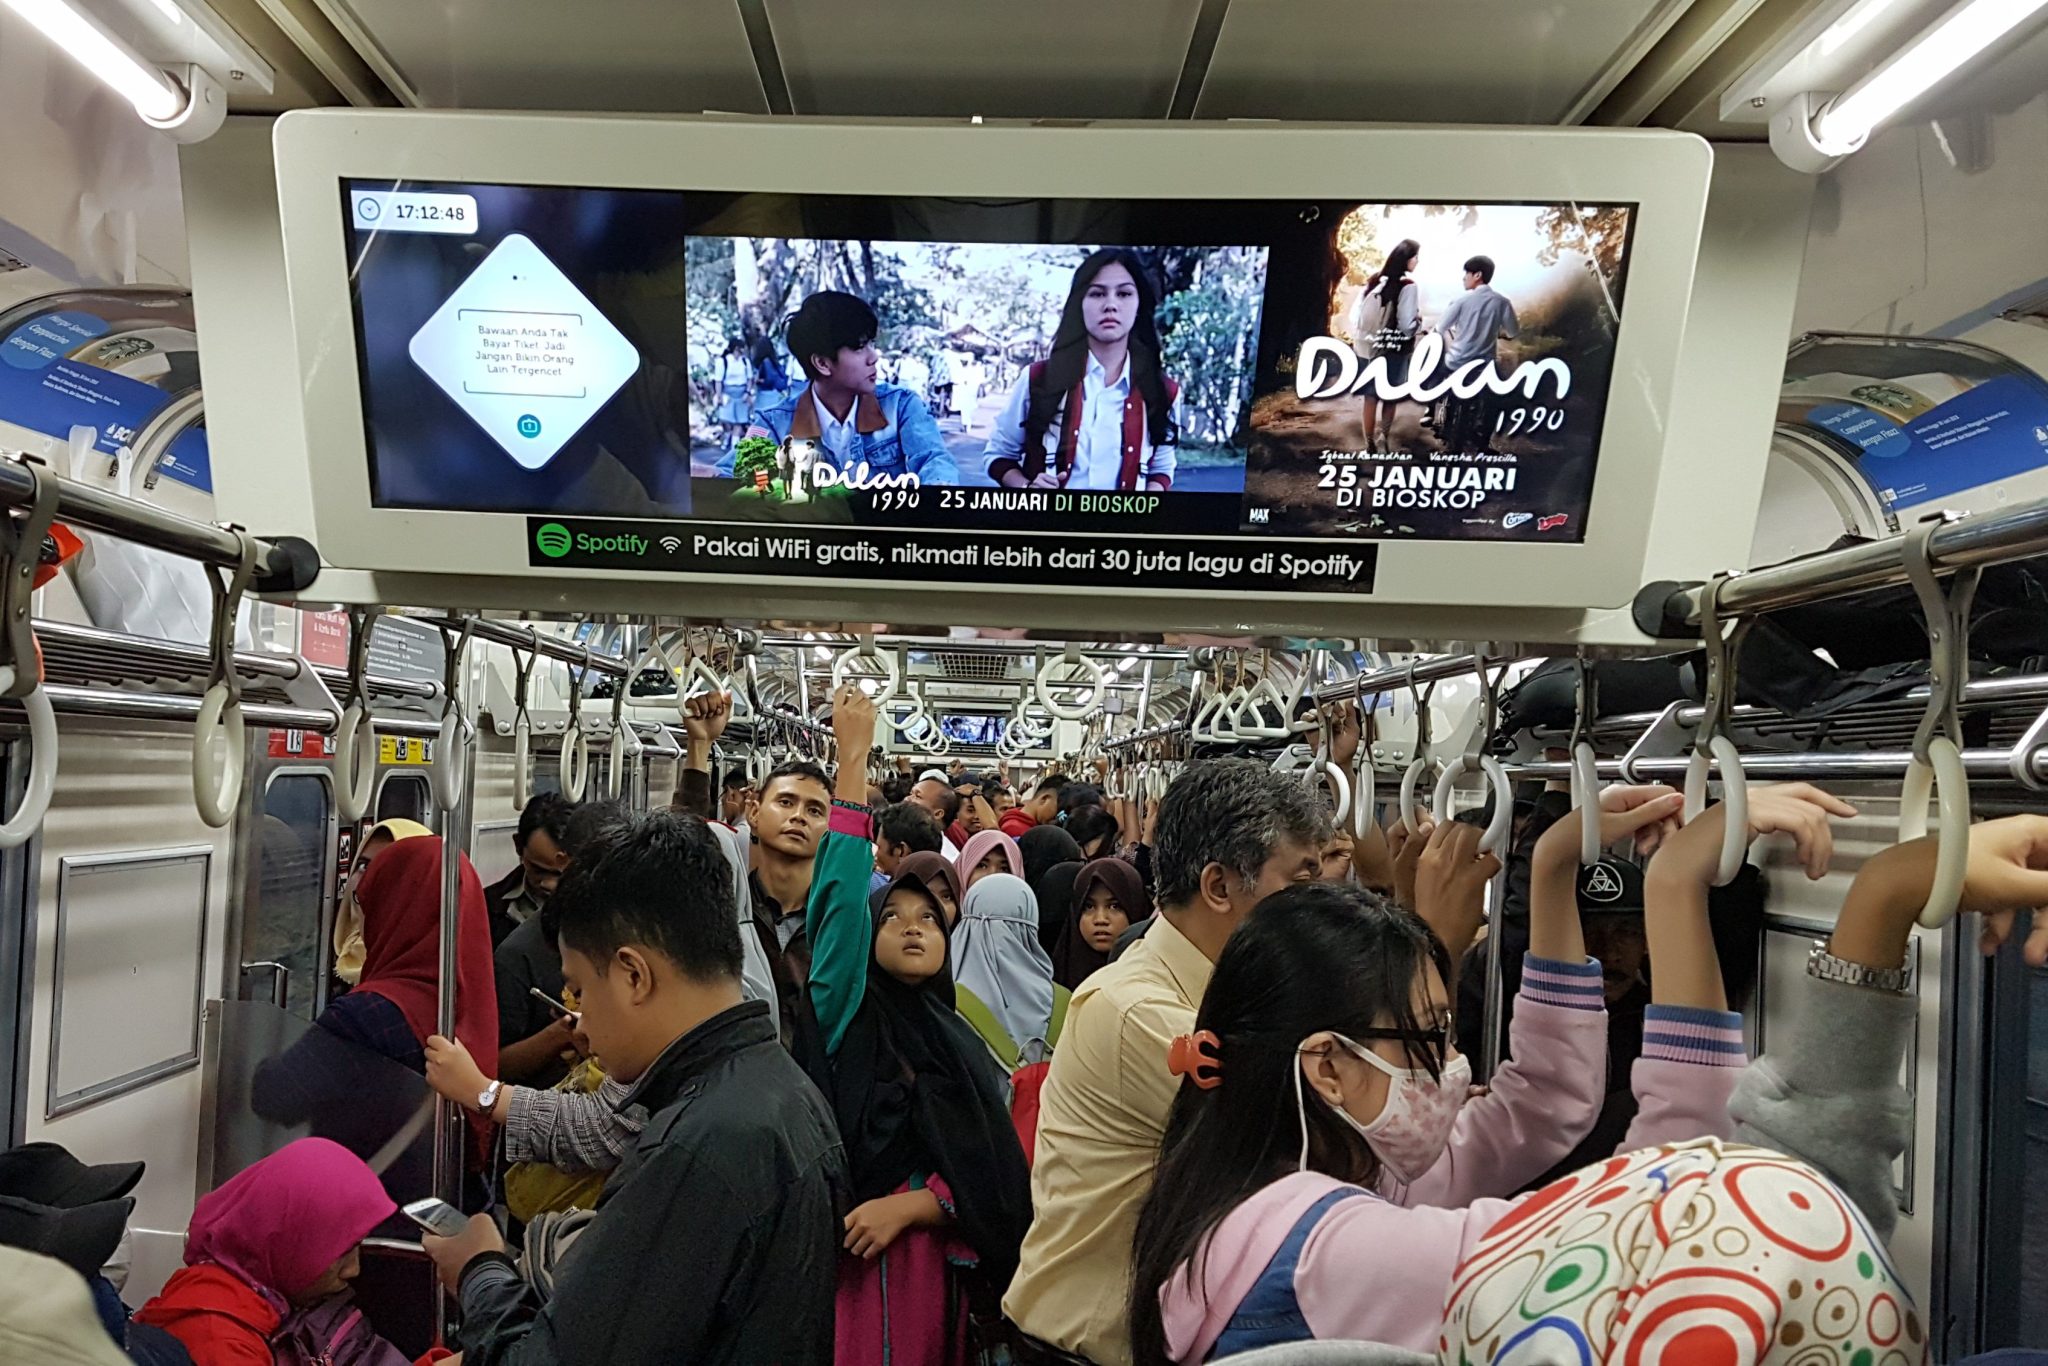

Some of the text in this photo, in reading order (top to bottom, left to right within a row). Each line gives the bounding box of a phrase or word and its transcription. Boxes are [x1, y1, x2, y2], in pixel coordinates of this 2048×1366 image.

[396, 204, 465, 220] 17:12:48
[478, 325, 568, 338] Bawaan Anda Tak
[483, 338, 510, 349] Bayar
[544, 341, 566, 350] Jadi
[475, 351, 574, 366] Jangan Bikin Orang
[1295, 332, 1571, 400] Dilan
[487, 364, 562, 376] Lain Tergencet
[1495, 406, 1565, 436] 1990
[1357, 449, 1413, 461] Ramadhan
[1474, 452, 1517, 462] Prescilla
[812, 460, 920, 489] Dilan
[1317, 464, 1517, 491] 25 JANUARI
[871, 491, 921, 511] 1990
[939, 489, 1161, 514] 25 JANUARI DI BIOSKOP
[1336, 488, 1486, 509] DI BIOSKOP
[1249, 508, 1270, 521] MAX
[576, 532, 1363, 580] Spotify Pakai WiFi gratis, nikmati lebih dari 30 juta lagu di Spotify
